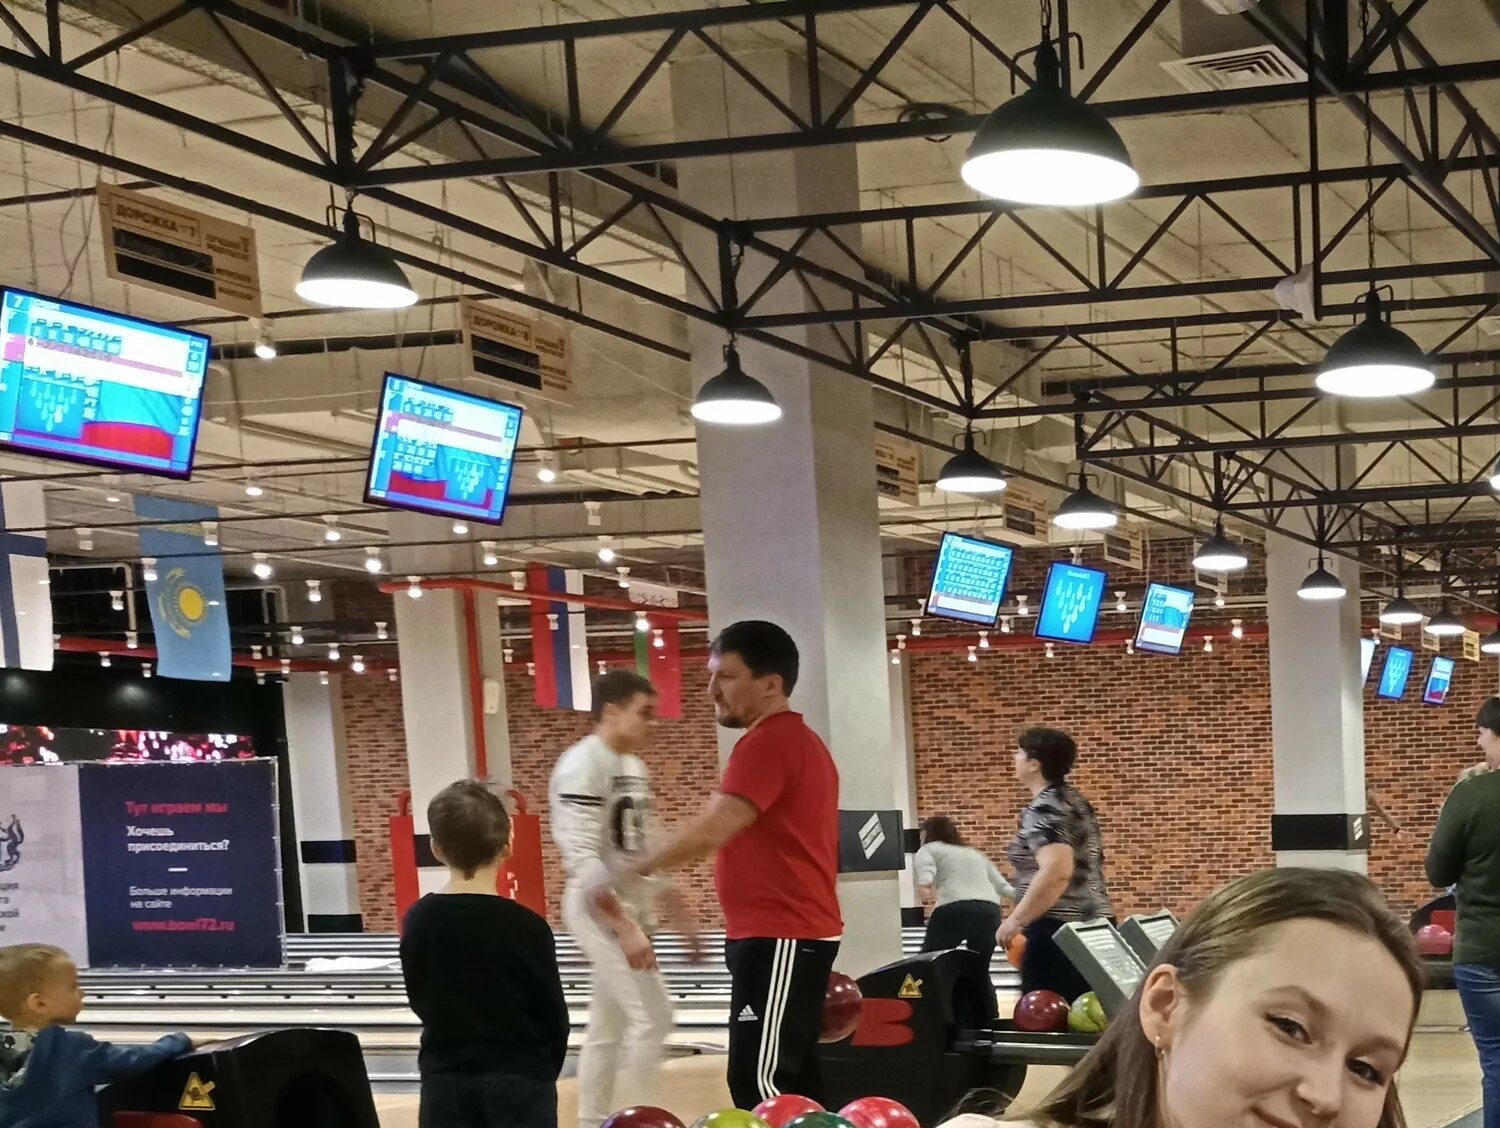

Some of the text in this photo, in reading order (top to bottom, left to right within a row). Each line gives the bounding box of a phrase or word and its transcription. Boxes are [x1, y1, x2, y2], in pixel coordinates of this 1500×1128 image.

[125, 801, 228, 817] Тут играем мы
[126, 825, 175, 837] Хочешь
[127, 839, 231, 854] присоединиться?
[129, 886, 233, 897] Больше информации
[144, 899, 172, 909] сайте
